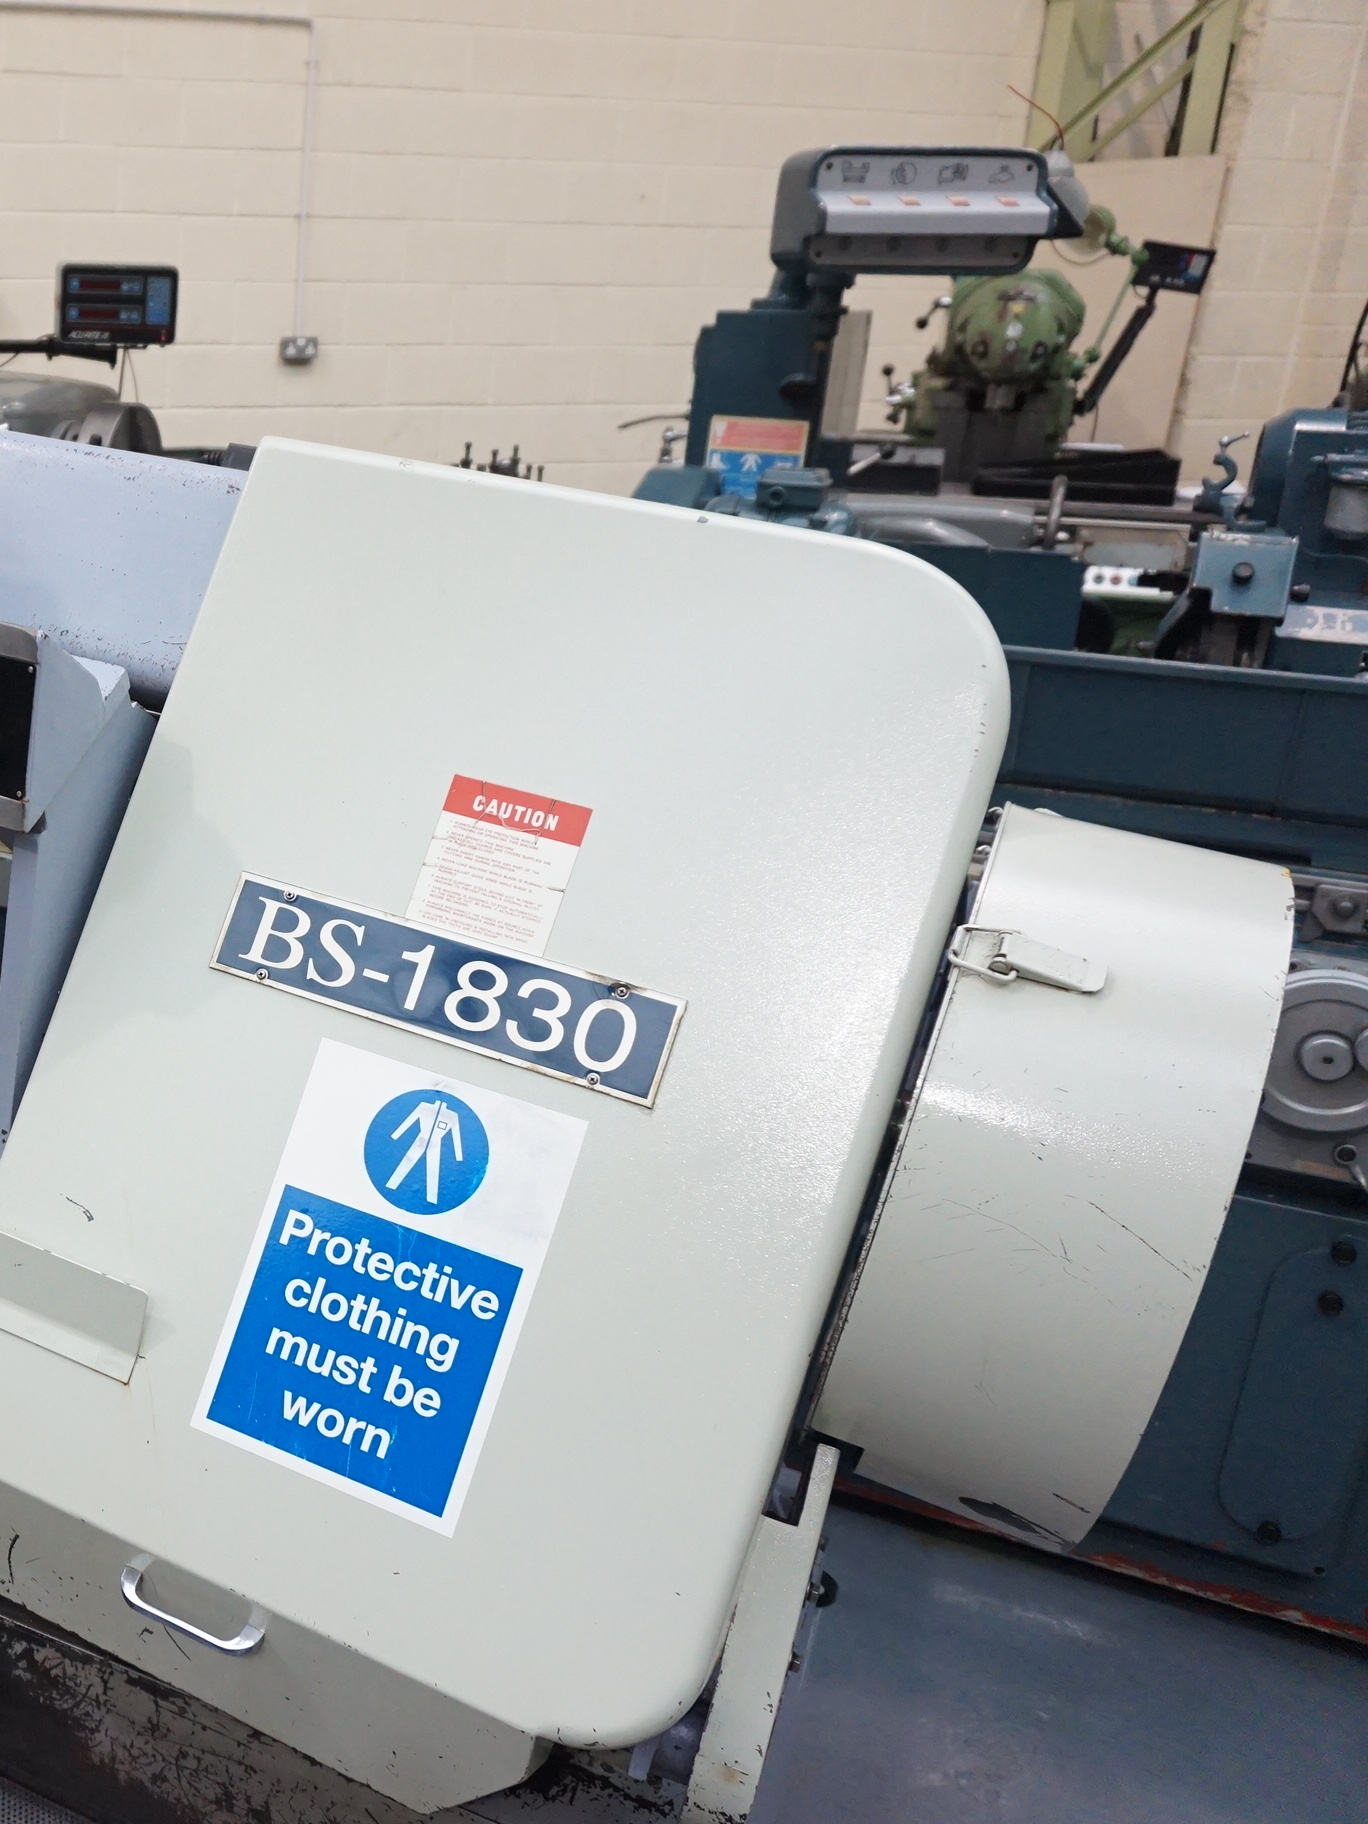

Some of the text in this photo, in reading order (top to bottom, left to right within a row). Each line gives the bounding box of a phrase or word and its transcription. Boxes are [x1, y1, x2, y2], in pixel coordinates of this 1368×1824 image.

[472, 795, 560, 832] CAUTION
[238, 896, 637, 1072] BS-1830
[279, 1209, 500, 1321] Protective
[284, 1276, 460, 1373] clothing
[265, 1326, 441, 1418] must be
[282, 1389, 392, 1459] worn
